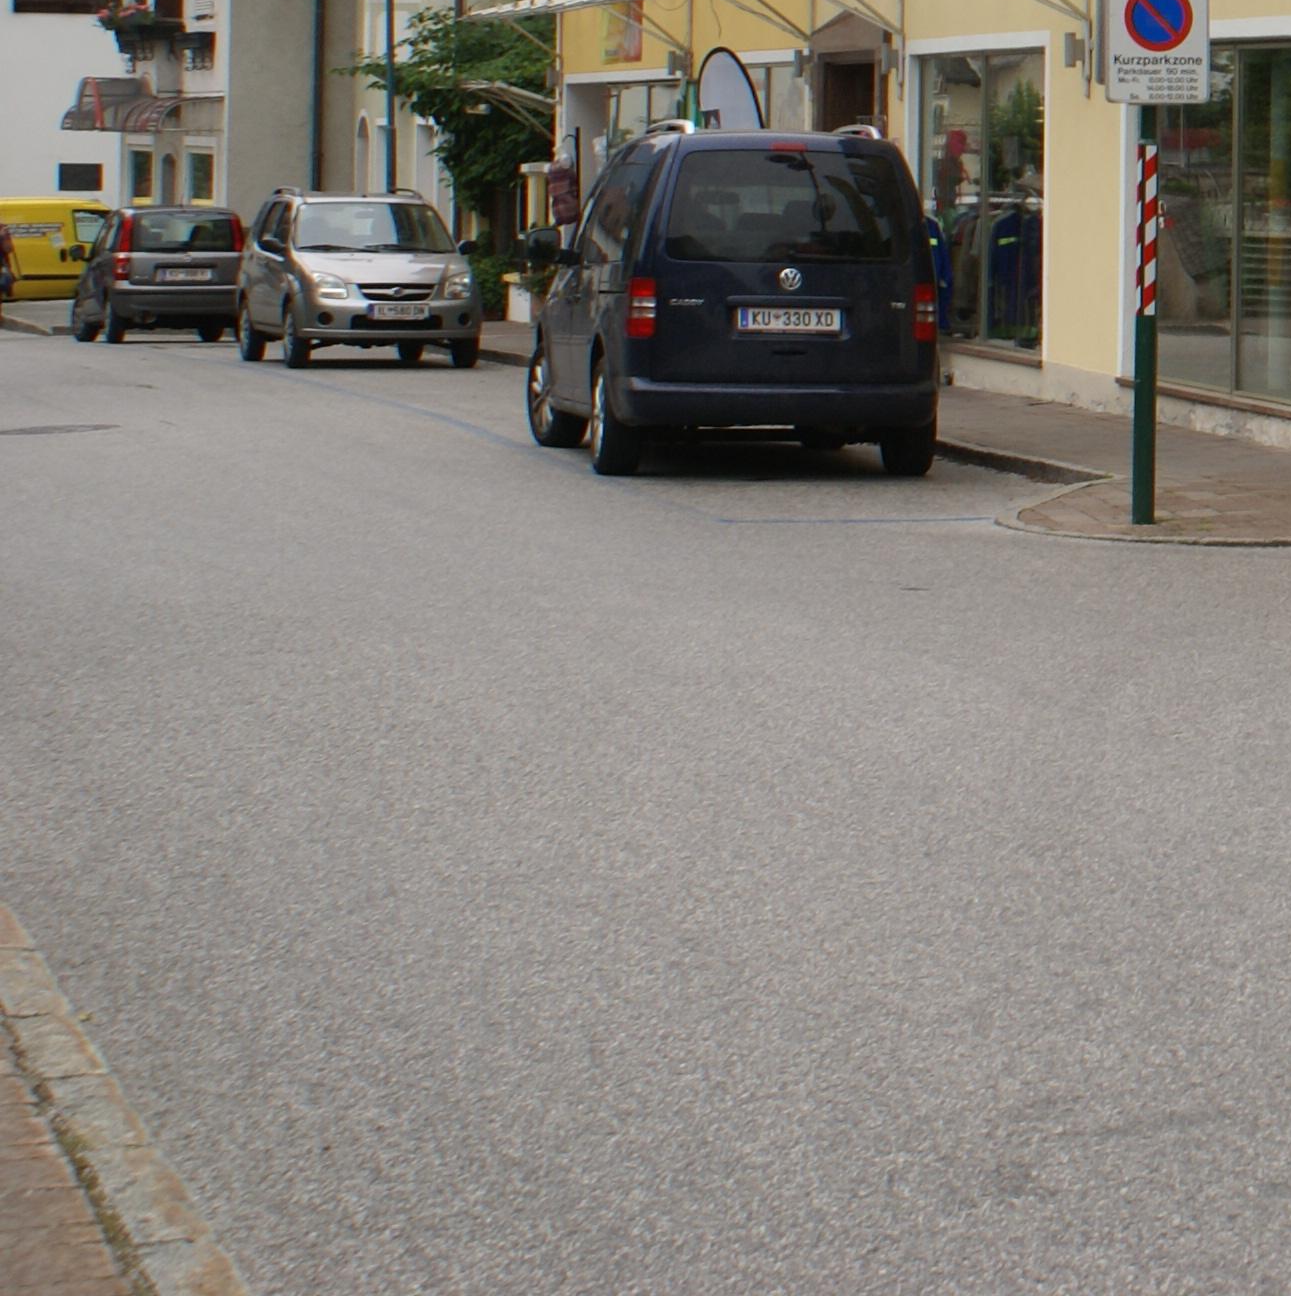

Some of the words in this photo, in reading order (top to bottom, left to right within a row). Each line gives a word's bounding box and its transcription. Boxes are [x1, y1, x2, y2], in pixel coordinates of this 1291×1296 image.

[1114, 54, 1203, 67] Kurzparkzone
[752, 310, 772, 327] KU
[783, 311, 812, 327] 330
[815, 312, 834, 327] XD
